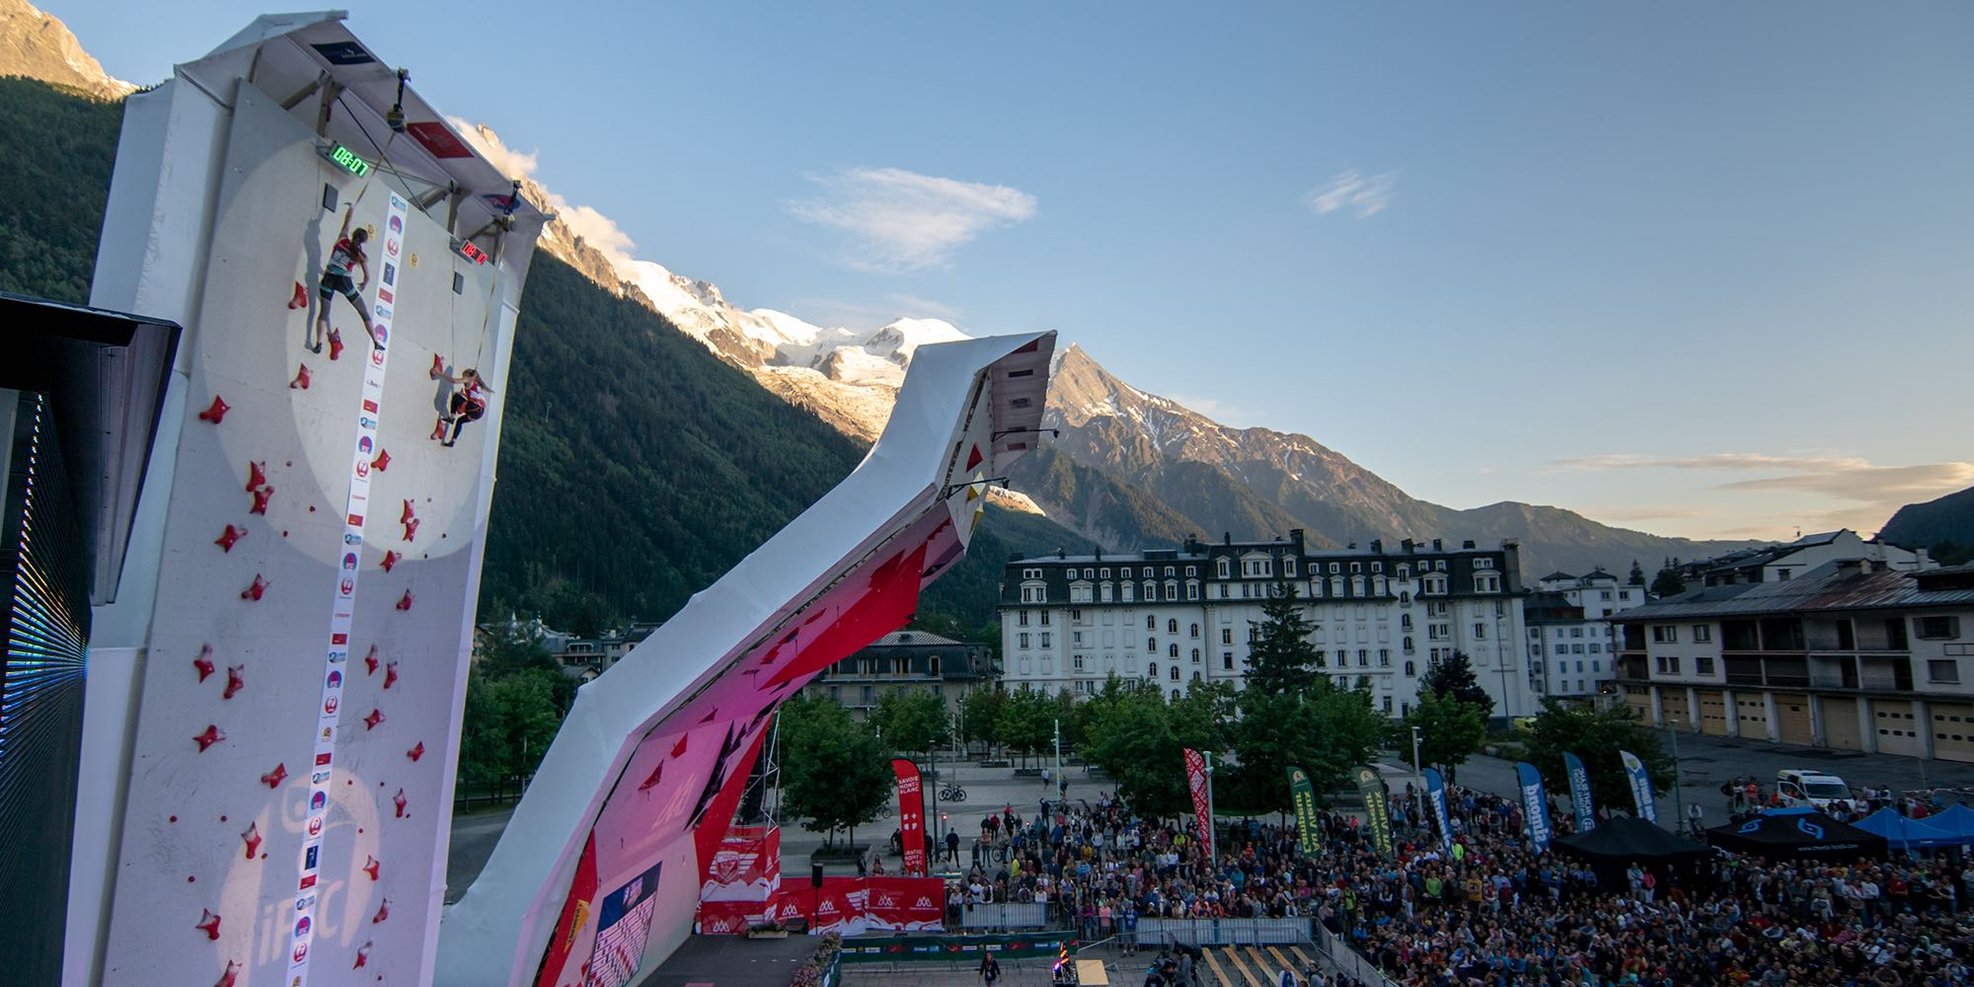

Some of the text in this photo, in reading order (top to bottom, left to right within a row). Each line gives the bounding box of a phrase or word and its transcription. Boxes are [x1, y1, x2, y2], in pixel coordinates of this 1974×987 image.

[333, 146, 369, 177] 08:07
[899, 776, 919, 785] SAVOIE
[899, 781, 915, 790] MONT
[899, 787, 920, 795] BLANC
